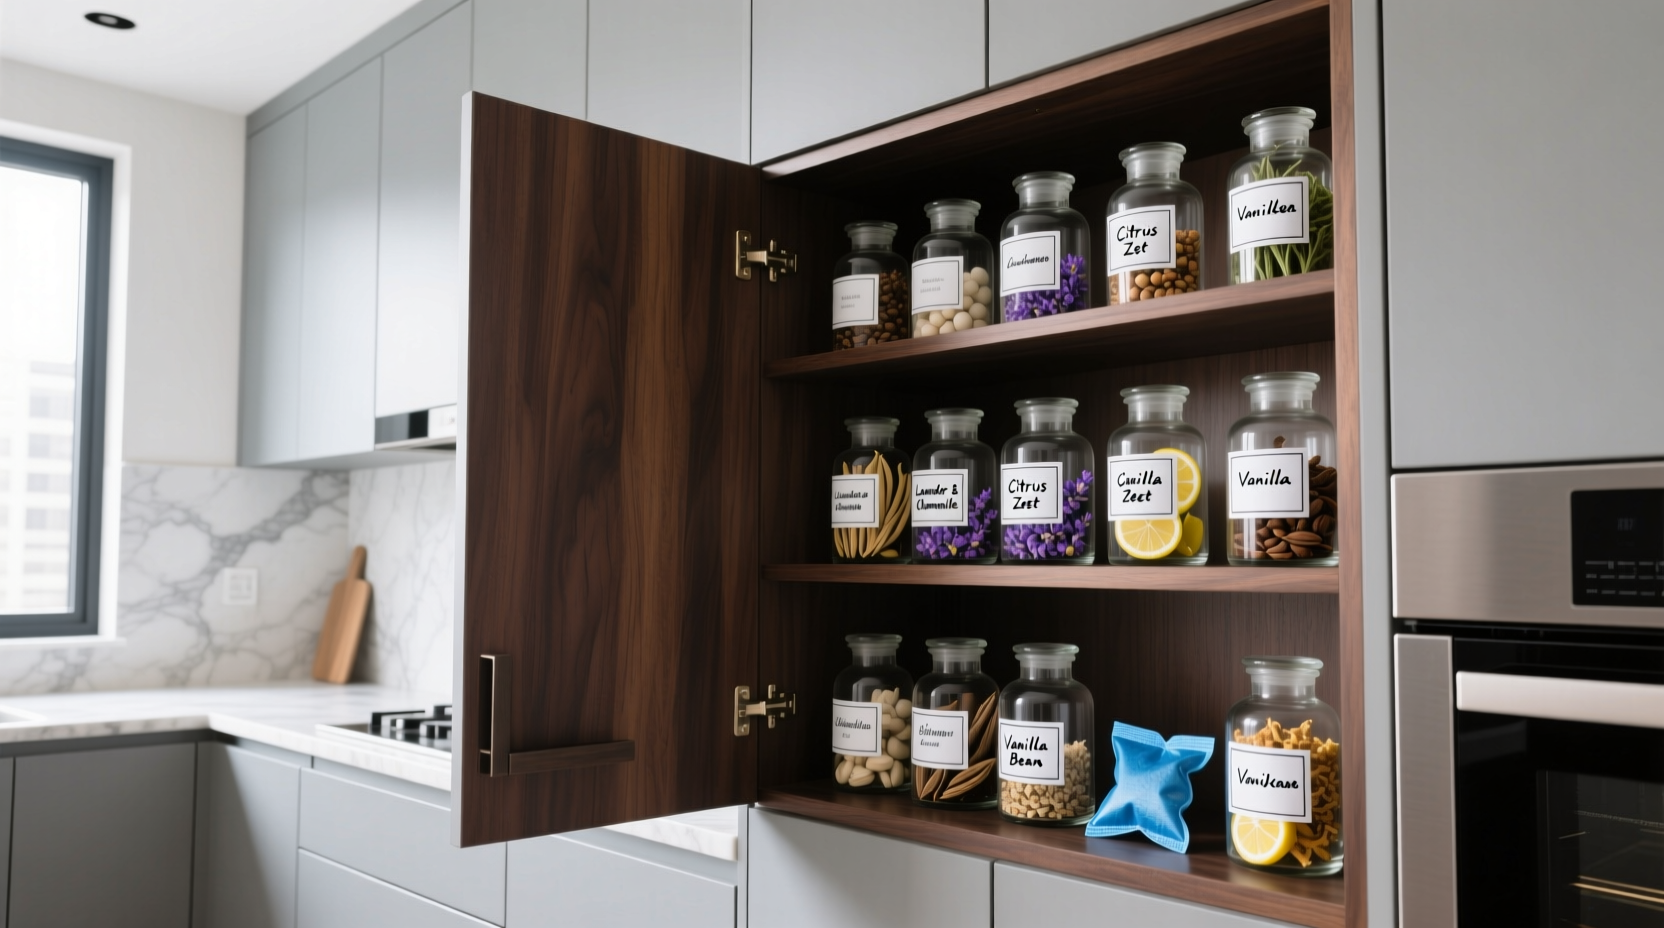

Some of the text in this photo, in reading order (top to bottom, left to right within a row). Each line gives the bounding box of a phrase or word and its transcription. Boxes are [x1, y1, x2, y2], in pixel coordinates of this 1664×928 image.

[1116, 224, 1158, 242] Citrus
[1123, 241, 1149, 256] Zet
[1008, 478, 1047, 493] Citrus
[1238, 468, 1292, 487] Vanilla
[1003, 732, 1049, 751] Vanilla
[1009, 751, 1043, 768] Bean
